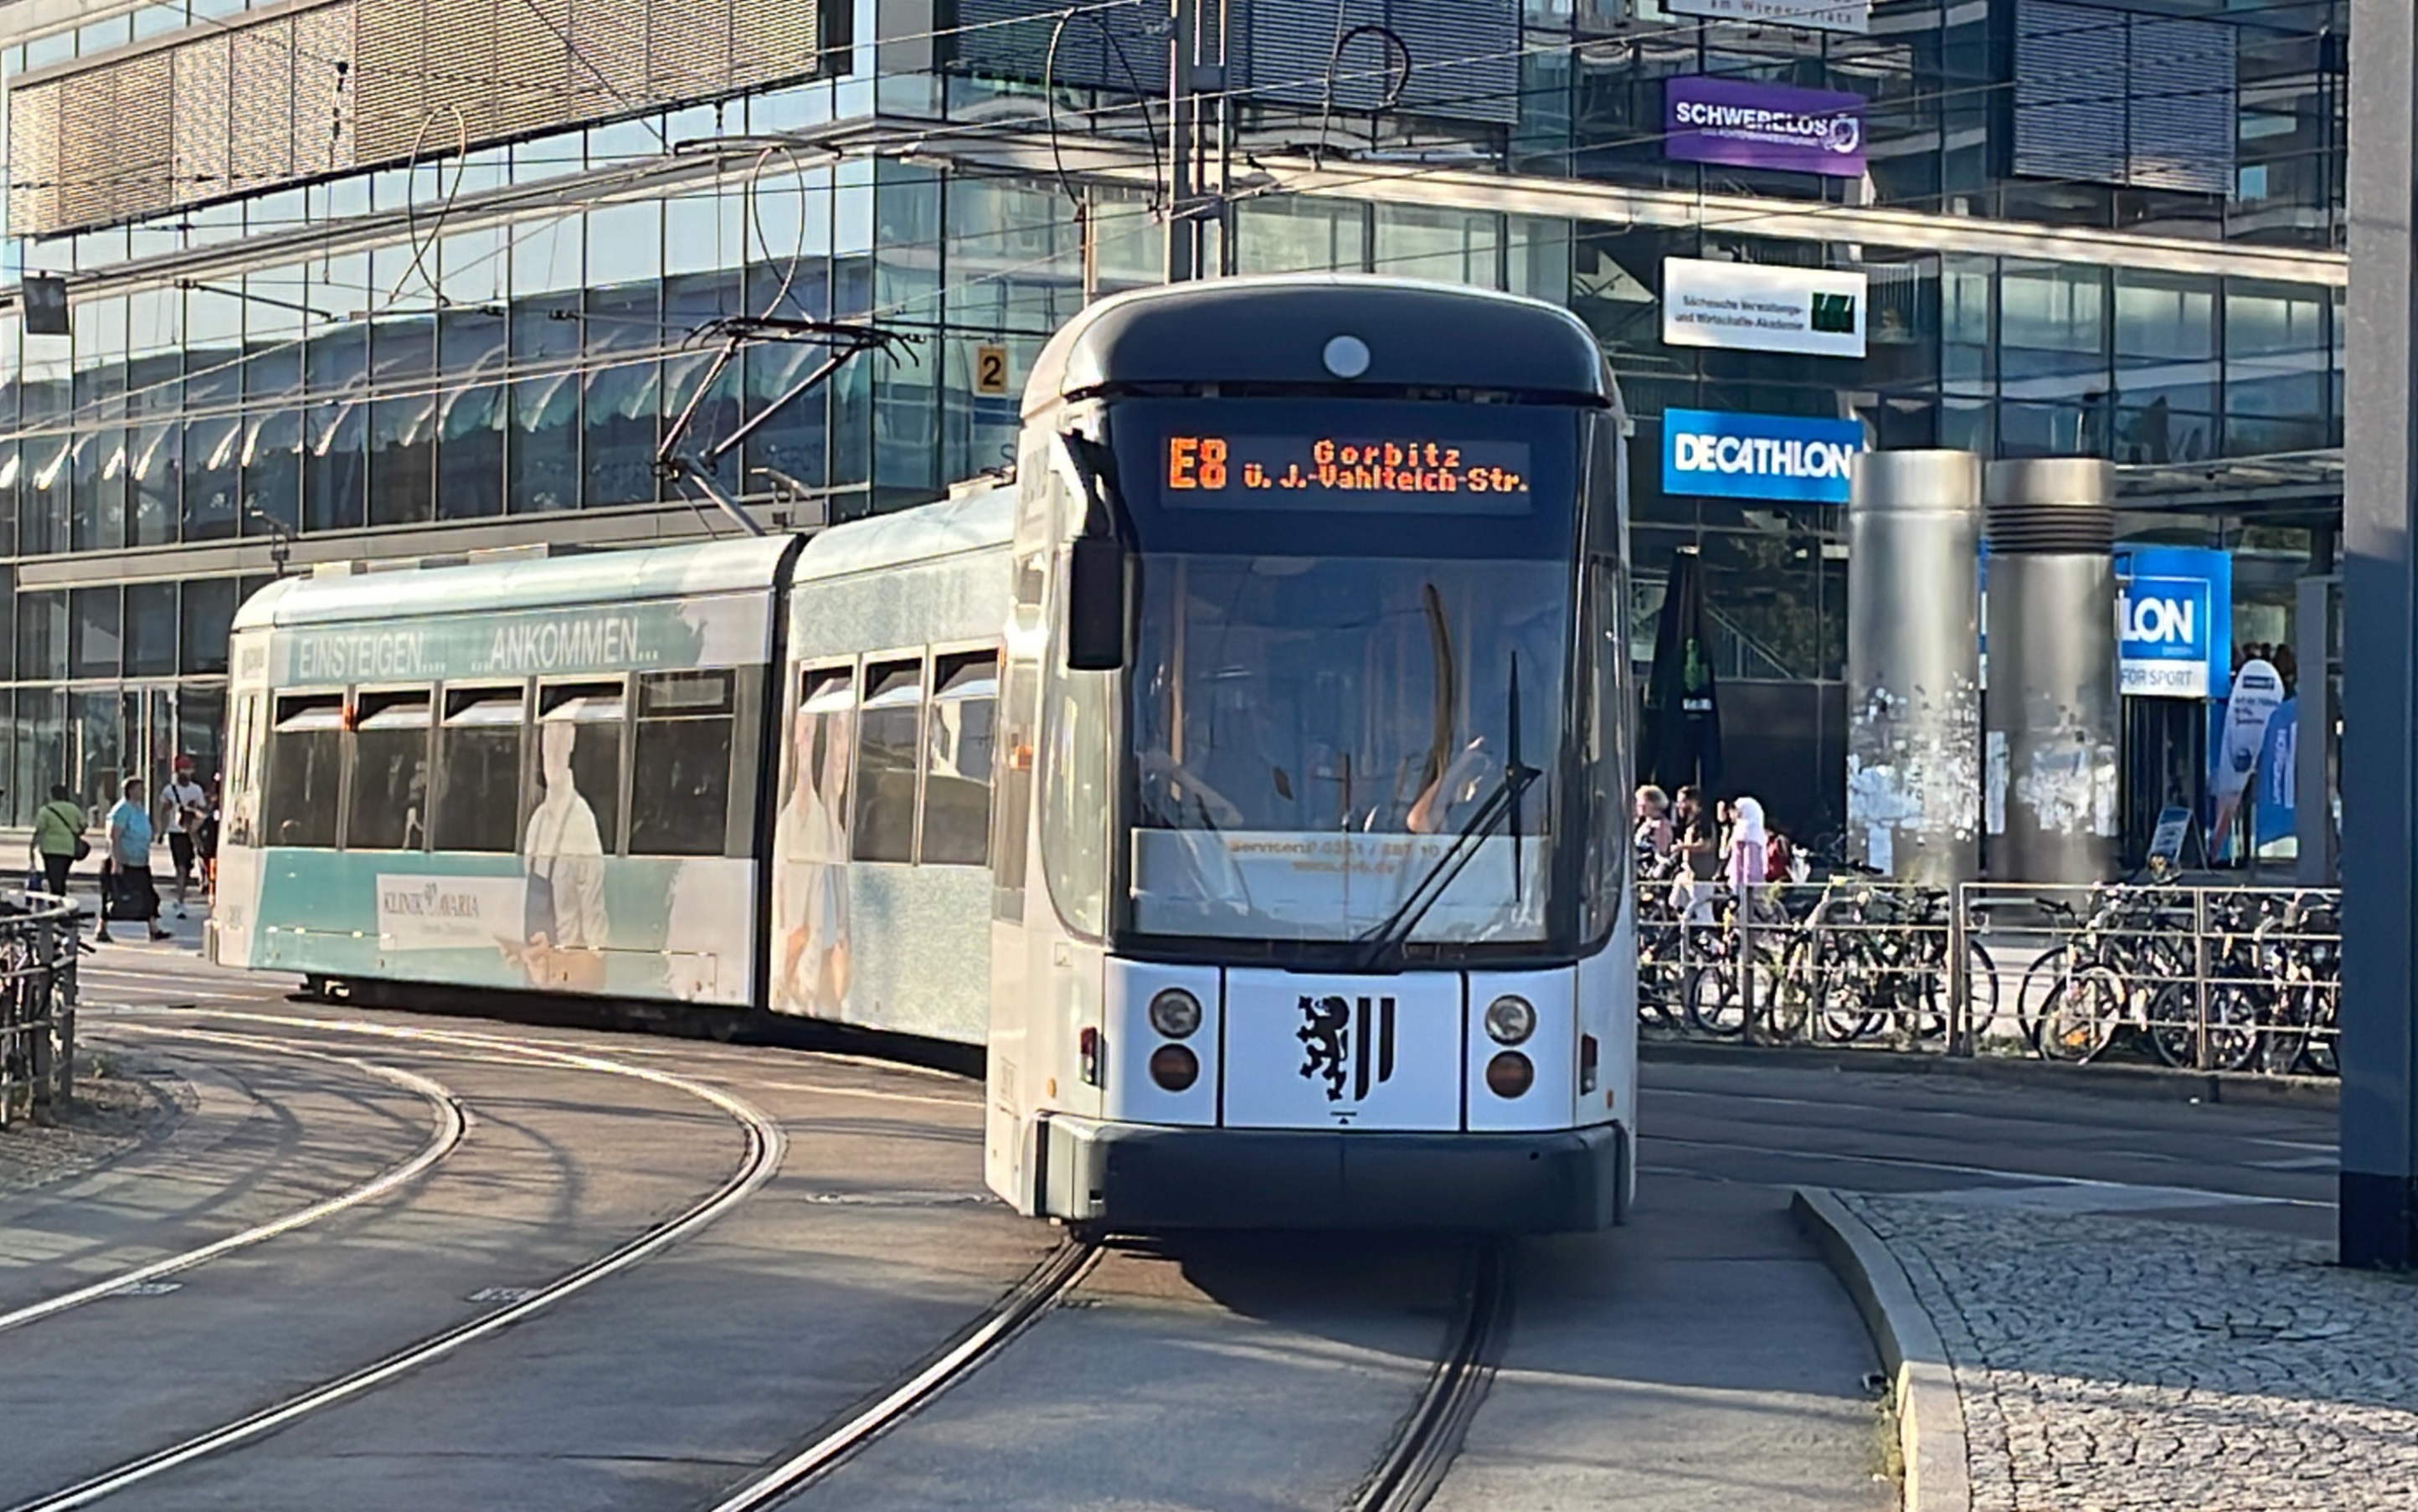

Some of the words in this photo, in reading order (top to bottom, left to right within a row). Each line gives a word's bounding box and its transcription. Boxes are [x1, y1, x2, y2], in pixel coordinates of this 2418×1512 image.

[1676, 101, 1829, 136] SCHWERELOS
[983, 356, 1001, 386] 2
[1170, 437, 1227, 490] E8
[1314, 440, 1460, 468] Gorbitz
[1675, 433, 1854, 480] DECATHLON
[1244, 463, 1272, 489] ü.
[2119, 596, 2194, 644] LON
[2148, 669, 2193, 687] SPORT
